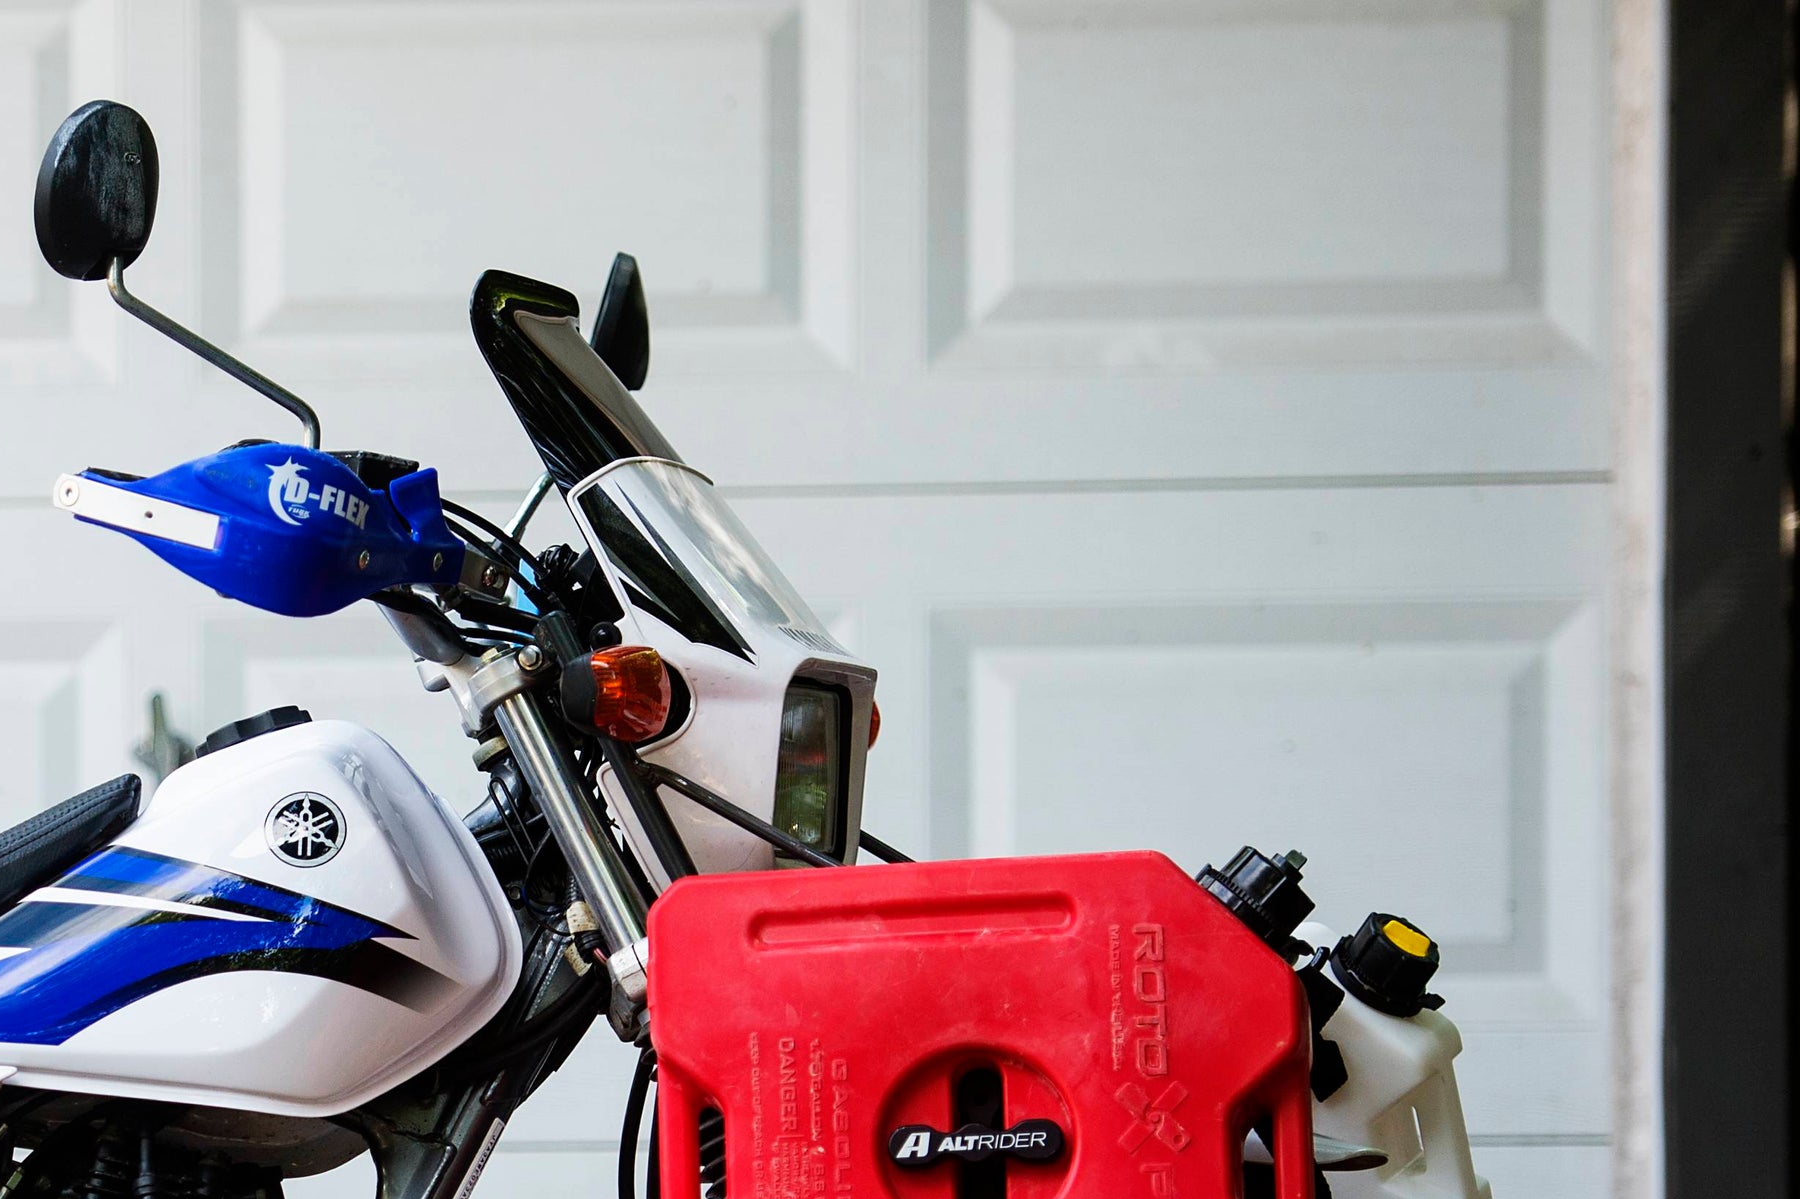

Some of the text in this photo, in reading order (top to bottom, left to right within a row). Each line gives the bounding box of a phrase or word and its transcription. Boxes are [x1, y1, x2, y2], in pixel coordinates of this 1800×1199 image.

[283, 474, 370, 531] D-FLEX
[1108, 924, 1121, 970] MADE
[1132, 922, 1169, 1079] ROTO
[751, 1067, 760, 1092] OUT
[779, 1037, 798, 1134] DANGER
[752, 1096, 761, 1113] OF
[810, 1078, 823, 1141] GALLON
[937, 1131, 1047, 1152] ALTRIDER
[753, 1160, 763, 1178] OR
